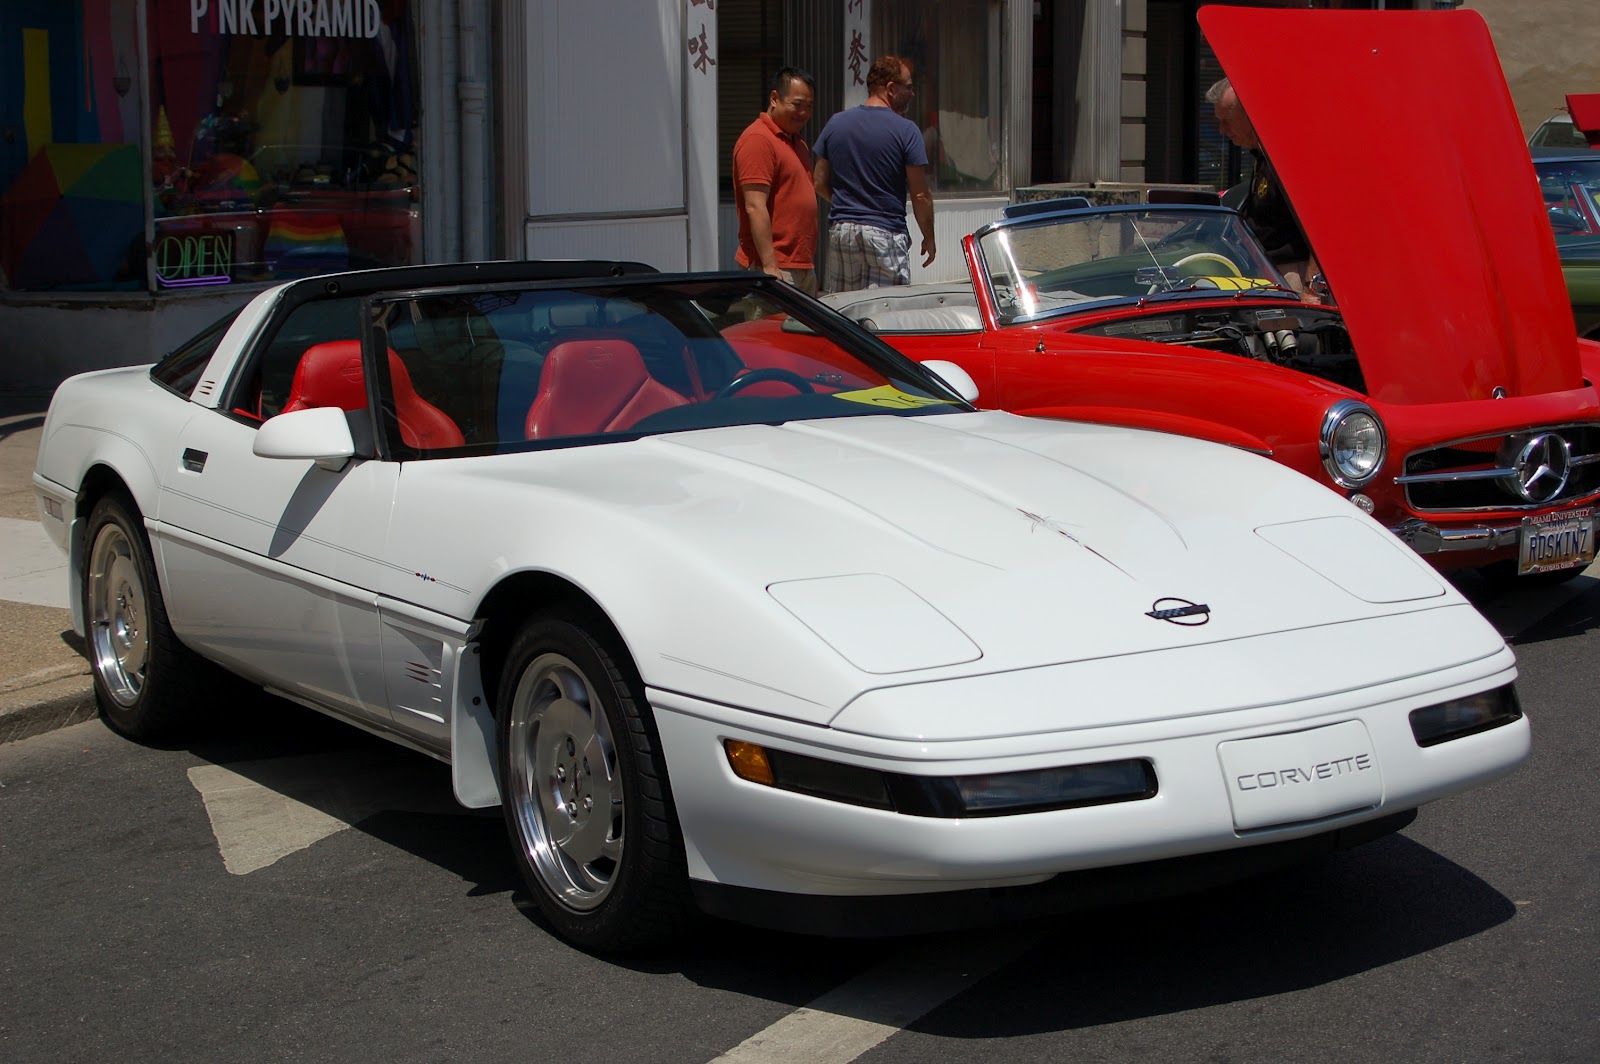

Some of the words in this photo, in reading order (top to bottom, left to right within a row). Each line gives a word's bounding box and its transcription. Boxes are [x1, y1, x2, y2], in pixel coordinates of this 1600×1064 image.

[264, 0, 380, 38] PYRAMID
[688, 0, 716, 75] 味
[156, 234, 232, 279] OPEN
[1530, 515, 1551, 525] MIAMI
[1551, 509, 1590, 520] UNIVERSITY
[1529, 528, 1588, 562] RDSKINZ
[1237, 753, 1372, 791] CORVETTE
